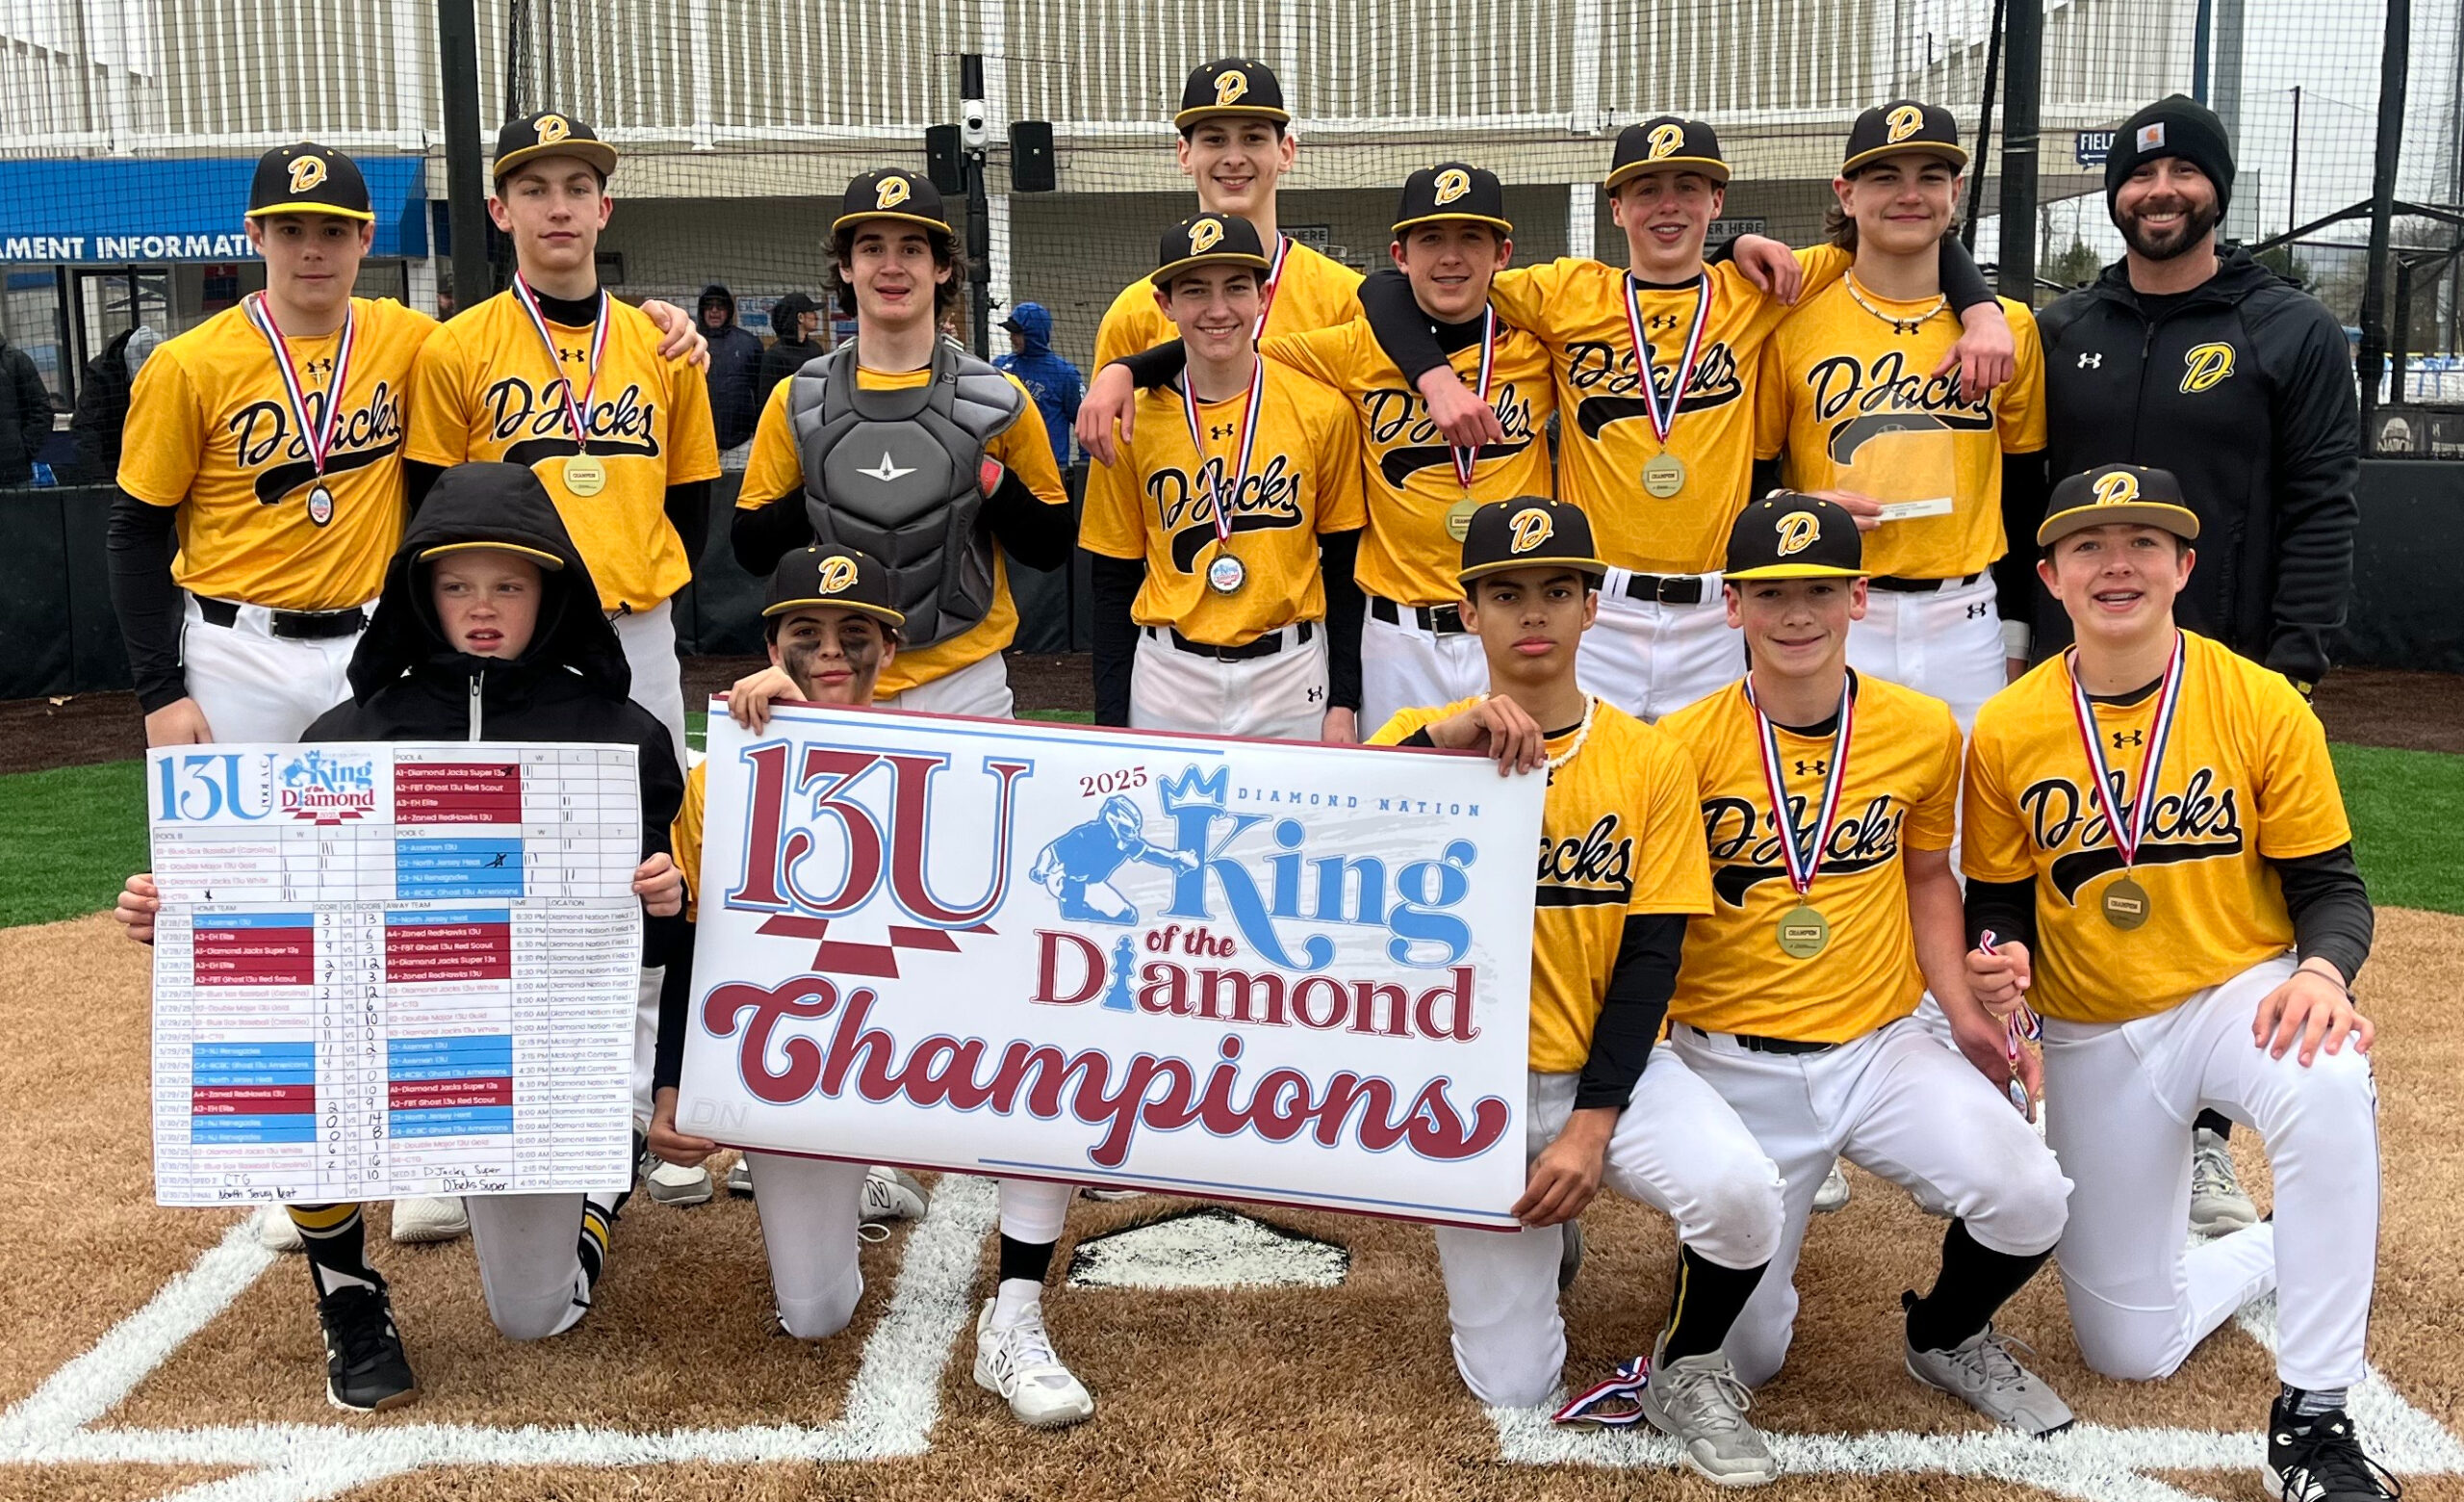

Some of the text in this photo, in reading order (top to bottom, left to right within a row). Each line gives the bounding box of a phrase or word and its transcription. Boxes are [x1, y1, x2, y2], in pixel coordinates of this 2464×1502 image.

[1728, 221, 1763, 234] HERE
[96, 234, 254, 259] INFORMATI
[2178, 341, 2236, 394] D
[156, 753, 279, 821] 13U
[306, 758, 373, 794] King
[470, 768, 492, 778] Super
[1079, 765, 1148, 798] 2025
[281, 789, 375, 807] Diamond
[1238, 787, 1481, 817] DIAMOND NATION
[724, 738, 1035, 930] 13U
[1156, 805, 1477, 972] King
[322, 914, 331, 925] 3
[1145, 924, 1239, 959] of the
[1030, 928, 1481, 1044] Diamond
[701, 974, 1512, 1167] Champions
